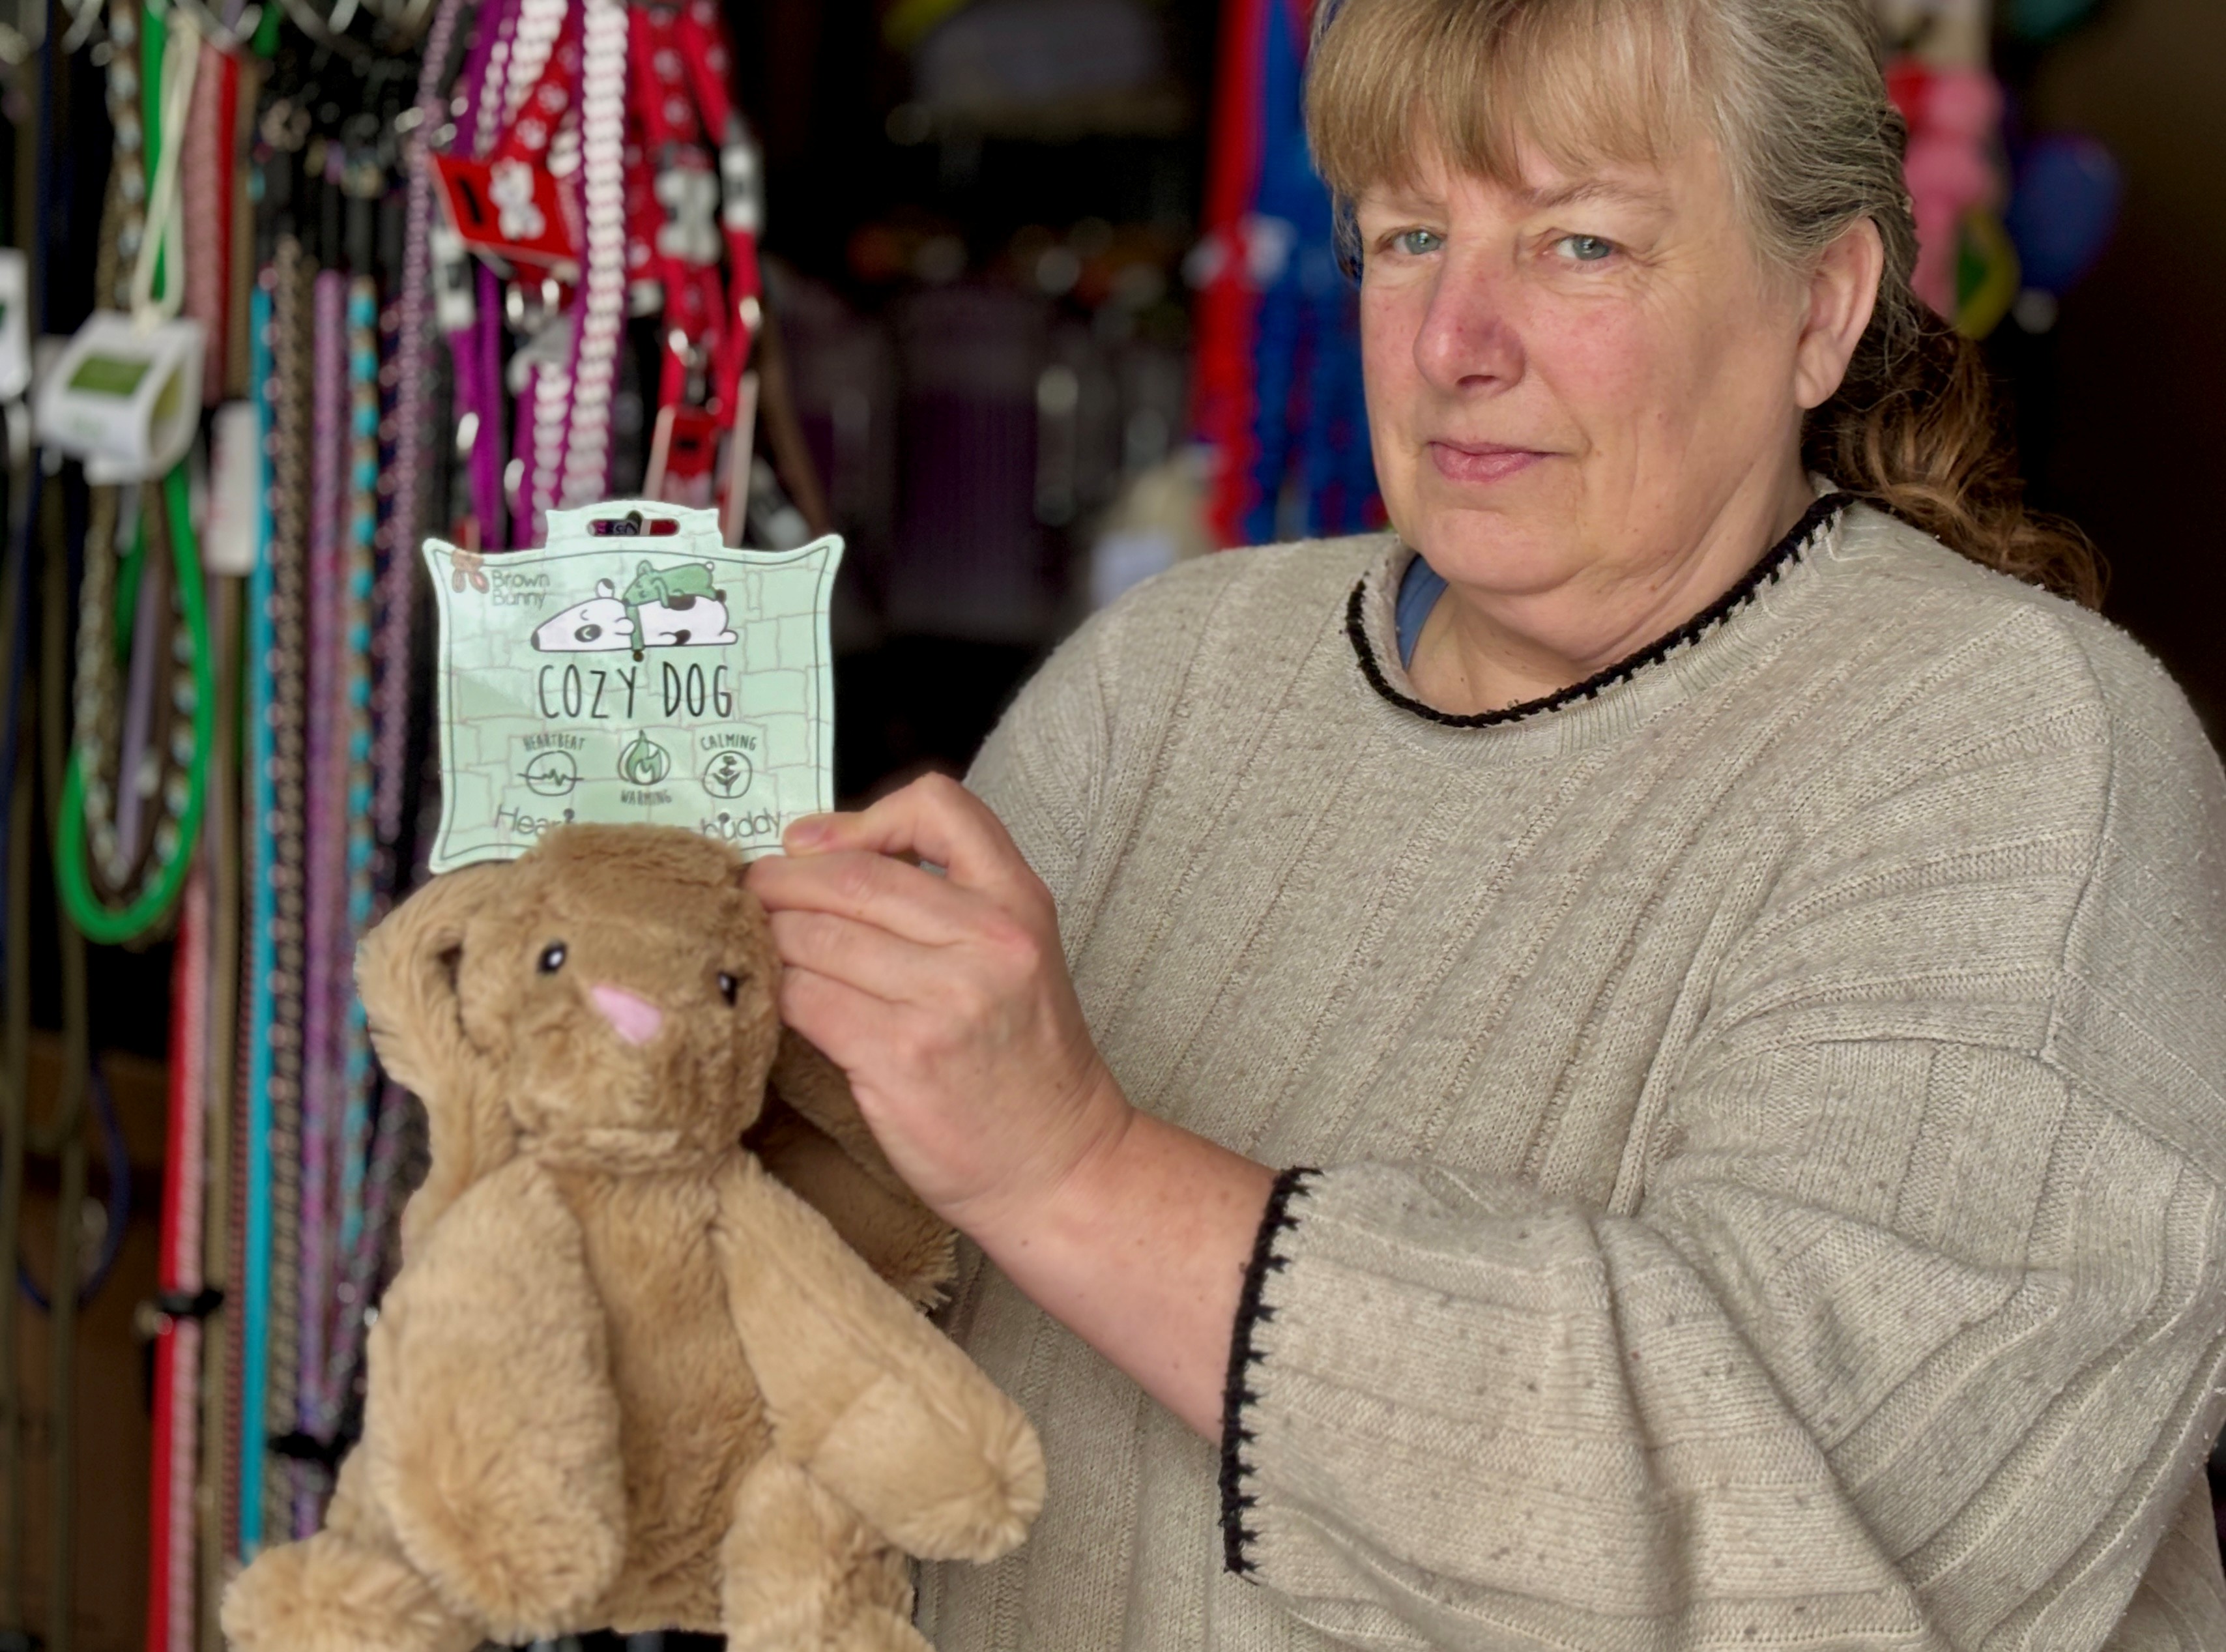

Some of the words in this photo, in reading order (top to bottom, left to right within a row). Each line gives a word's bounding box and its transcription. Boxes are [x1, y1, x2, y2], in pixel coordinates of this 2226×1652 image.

[492, 569, 550, 587] Brown
[493, 588, 546, 611] Bunny
[538, 664, 637, 719] COZY
[663, 661, 733, 718] DOG
[523, 733, 585, 751] HEARTBEAT
[701, 734, 757, 751] CALMING
[620, 789, 672, 805] WARMING
[494, 804, 575, 837] Hea
